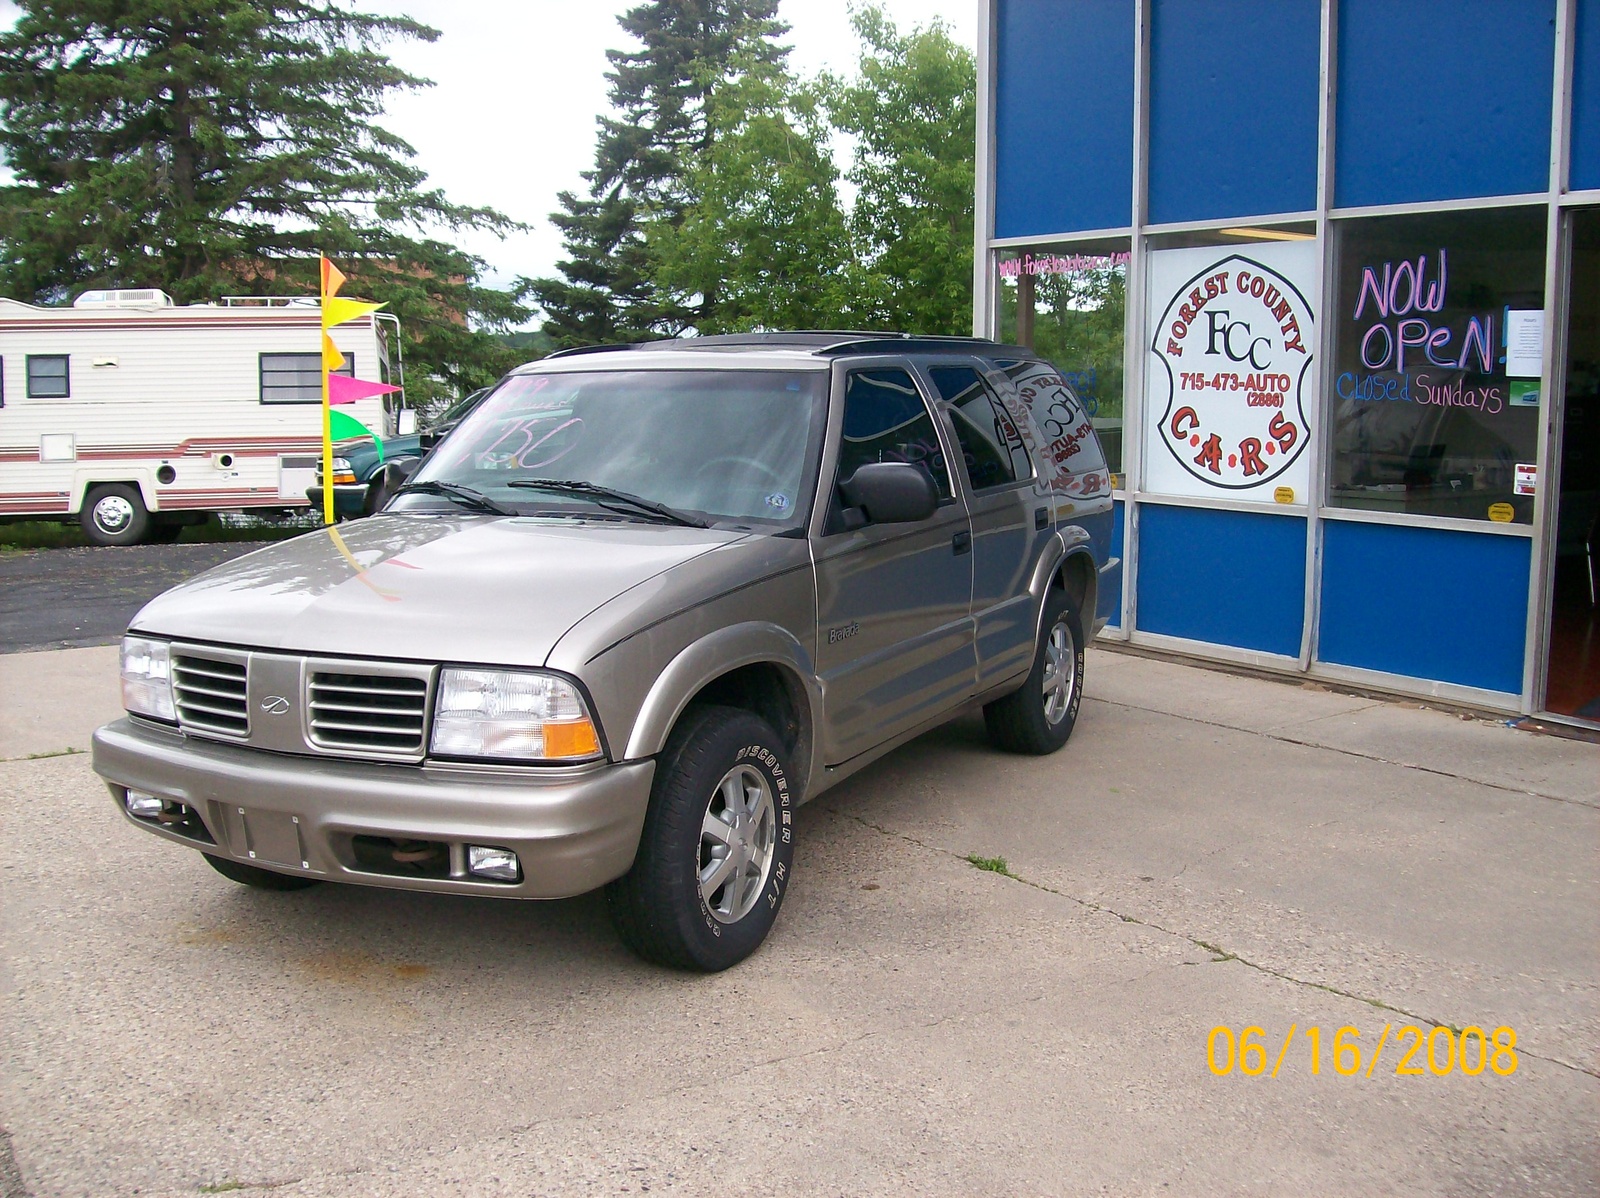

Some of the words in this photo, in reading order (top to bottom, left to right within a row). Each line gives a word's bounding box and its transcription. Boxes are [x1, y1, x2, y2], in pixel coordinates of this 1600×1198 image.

[1166, 271, 1229, 357] FOREST
[1236, 271, 1307, 355] COUNTY
[1353, 248, 1447, 320] NOW
[1203, 310, 1272, 371] FCC
[1180, 372, 1291, 393] 715-473-AUTO
[1246, 391, 1284, 408] (2886)
[735, 745, 791, 844] DISCOVERER
